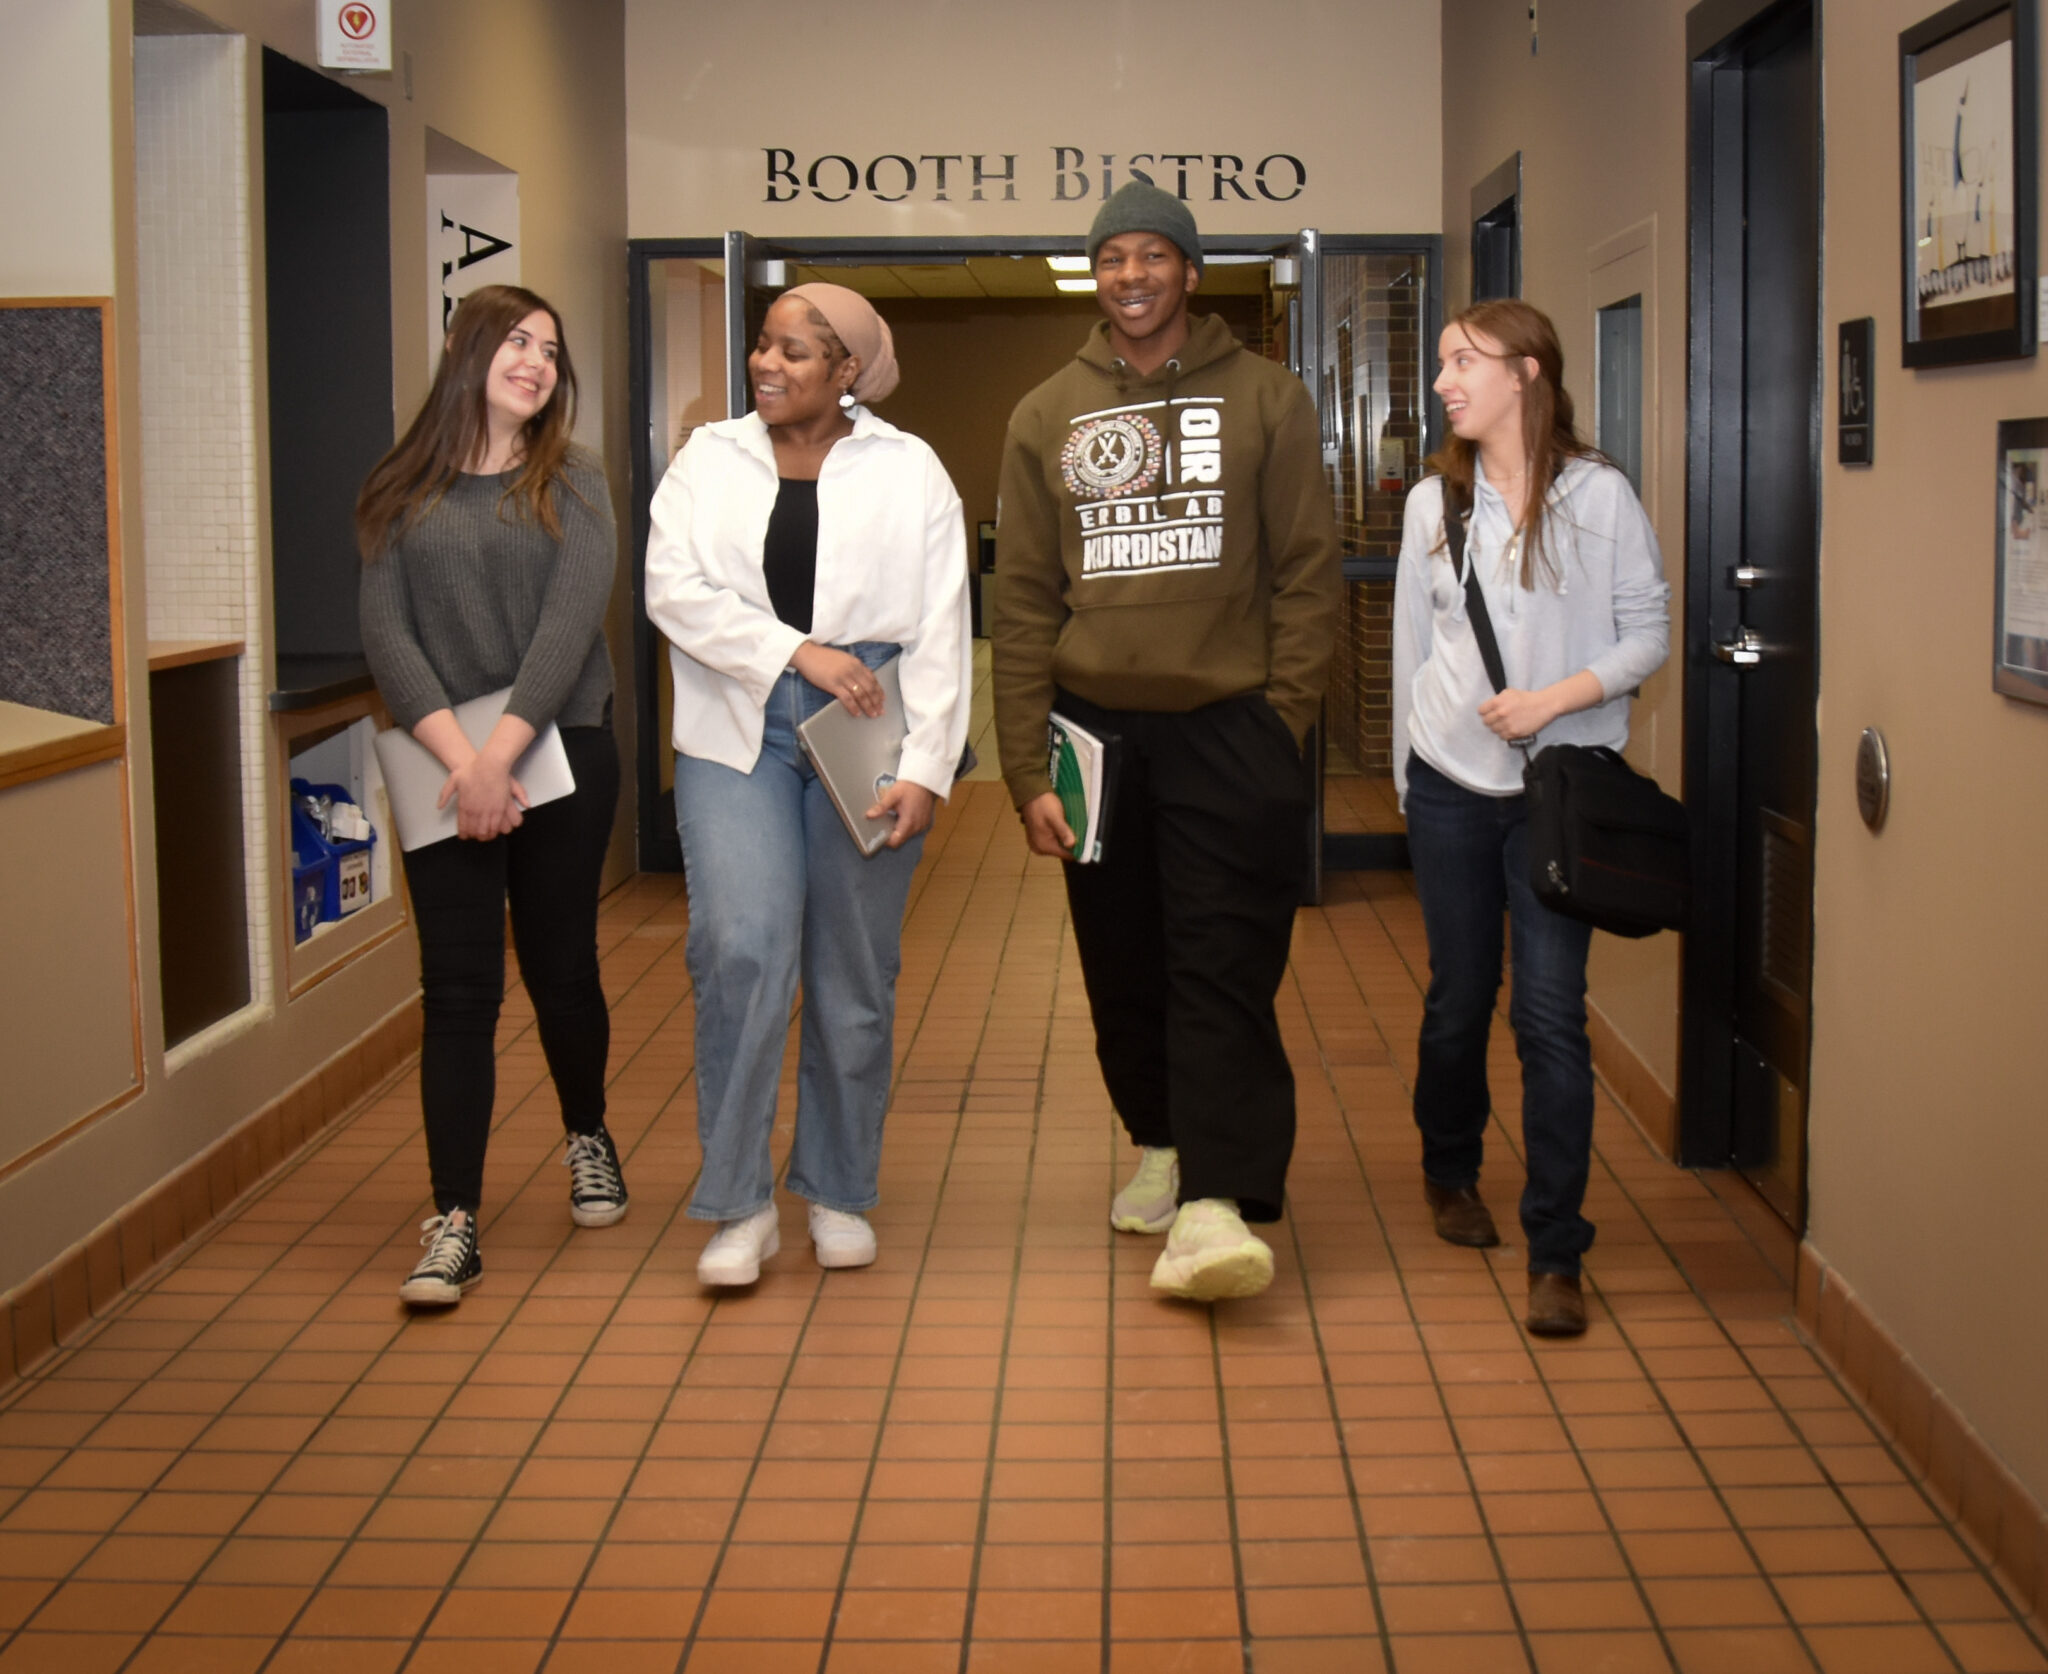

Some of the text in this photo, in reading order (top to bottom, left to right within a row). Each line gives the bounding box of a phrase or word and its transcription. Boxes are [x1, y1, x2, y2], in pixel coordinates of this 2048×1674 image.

[760, 146, 1307, 202] BOOTH BISTRO
[1079, 497, 1223, 529] ERBIL AB
[1082, 525, 1223, 572] KURDISTAN
